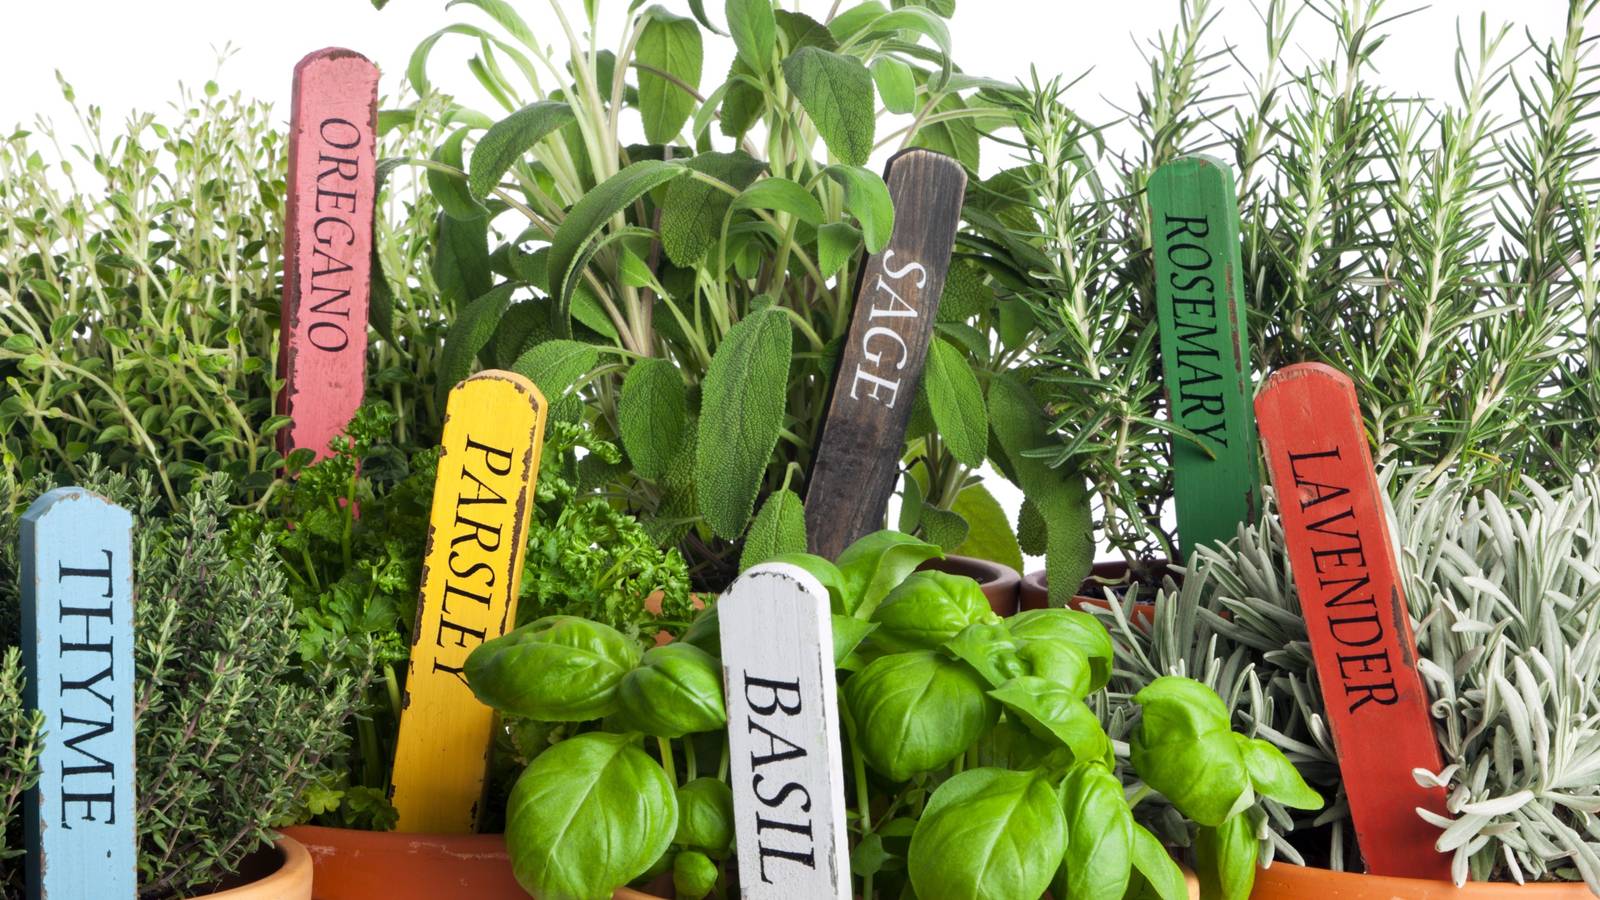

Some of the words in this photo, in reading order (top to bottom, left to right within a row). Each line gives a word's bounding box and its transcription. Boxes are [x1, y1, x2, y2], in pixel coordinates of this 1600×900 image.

[307, 118, 360, 353] OREGANO
[850, 249, 926, 408] SAGE
[1164, 213, 1226, 446] ROSEMARY
[58, 549, 115, 829] THYME
[1287, 446, 1398, 714] LAVENDER
[743, 670, 815, 883] BASIL
